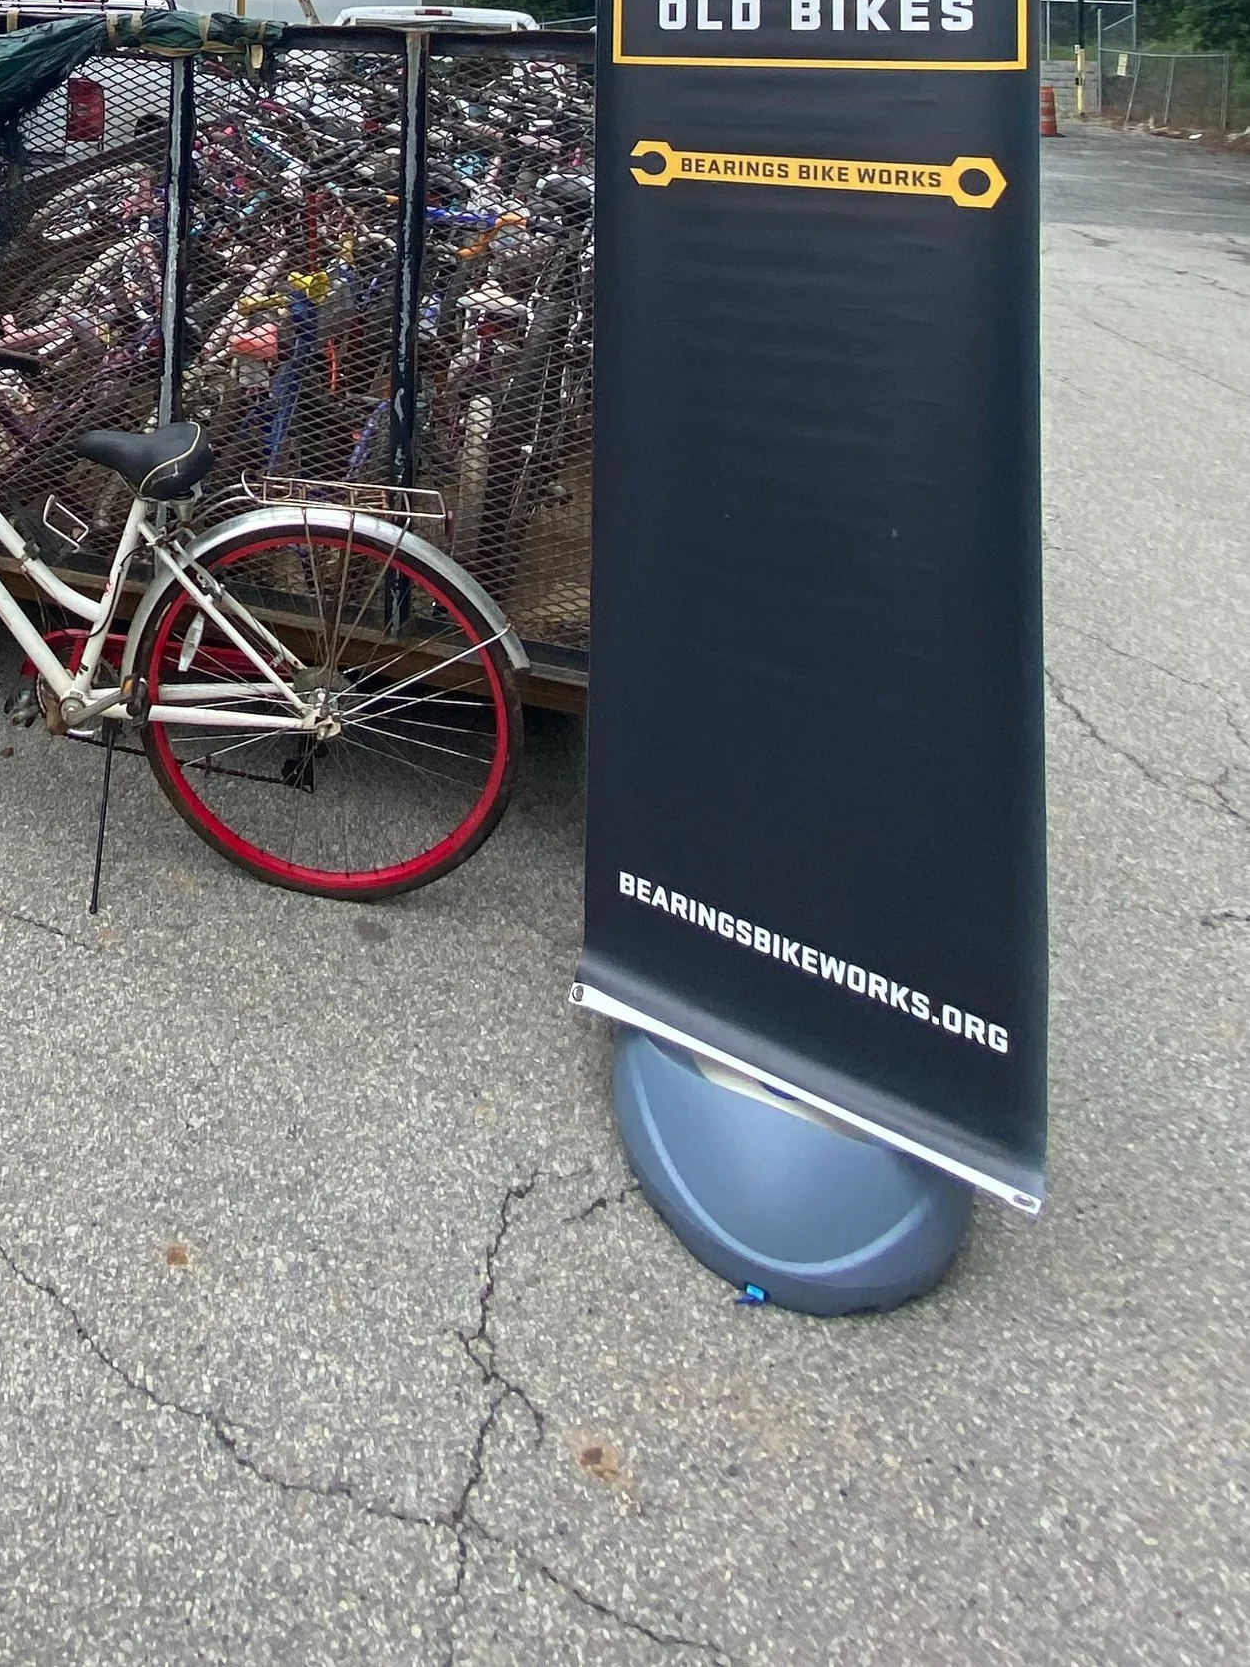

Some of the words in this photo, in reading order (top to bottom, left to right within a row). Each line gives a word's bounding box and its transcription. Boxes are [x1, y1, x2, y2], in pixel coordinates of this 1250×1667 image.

[681, 157, 789, 178] BEARINGS
[798, 164, 849, 182] BIKE
[857, 167, 942, 188] WORKS
[619, 871, 1008, 1054] BEARINGSBIKEWORKS.ORG
